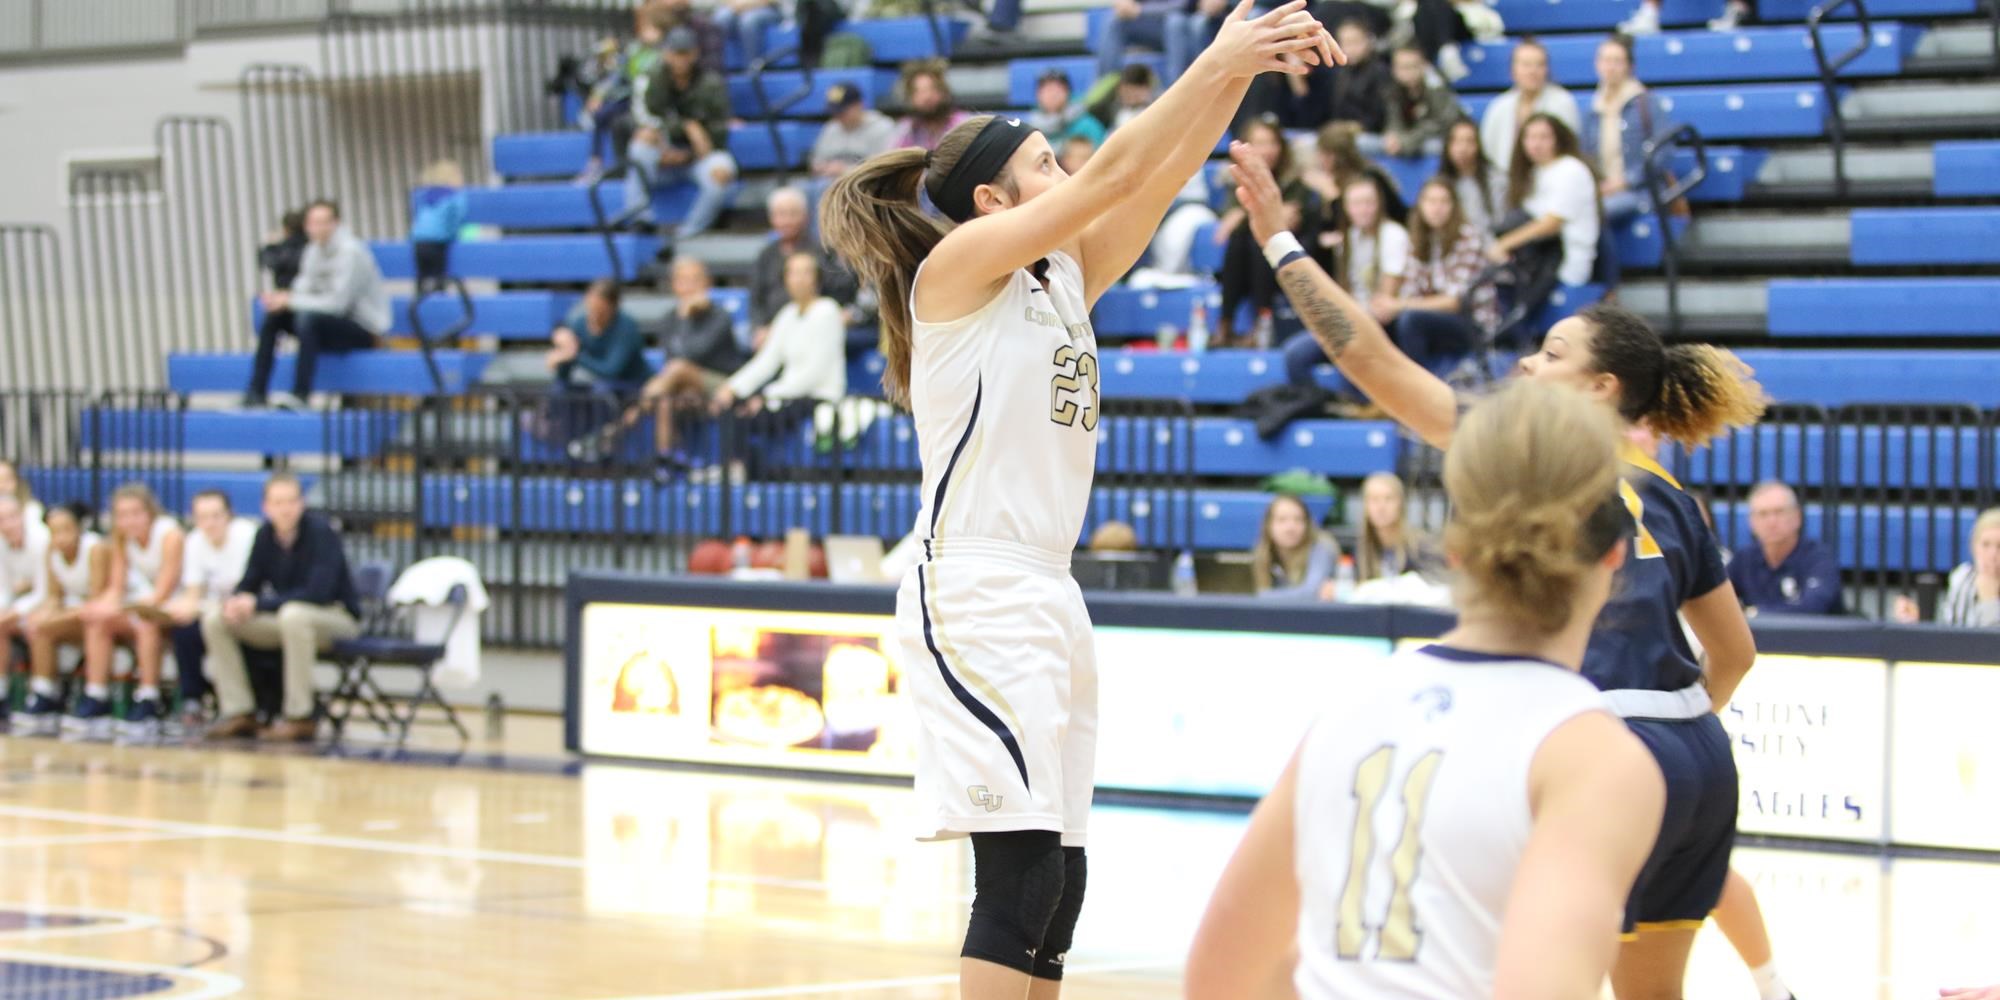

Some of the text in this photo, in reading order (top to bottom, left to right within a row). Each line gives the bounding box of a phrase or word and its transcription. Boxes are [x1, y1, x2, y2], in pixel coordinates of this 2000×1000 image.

[1051, 345, 1100, 432] 23
[1729, 701, 1834, 727] STONE
[1740, 733, 1807, 758] SITY
[967, 785, 1004, 813] CU
[1747, 789, 1863, 822] AGLES
[1336, 743, 1446, 963] 11
